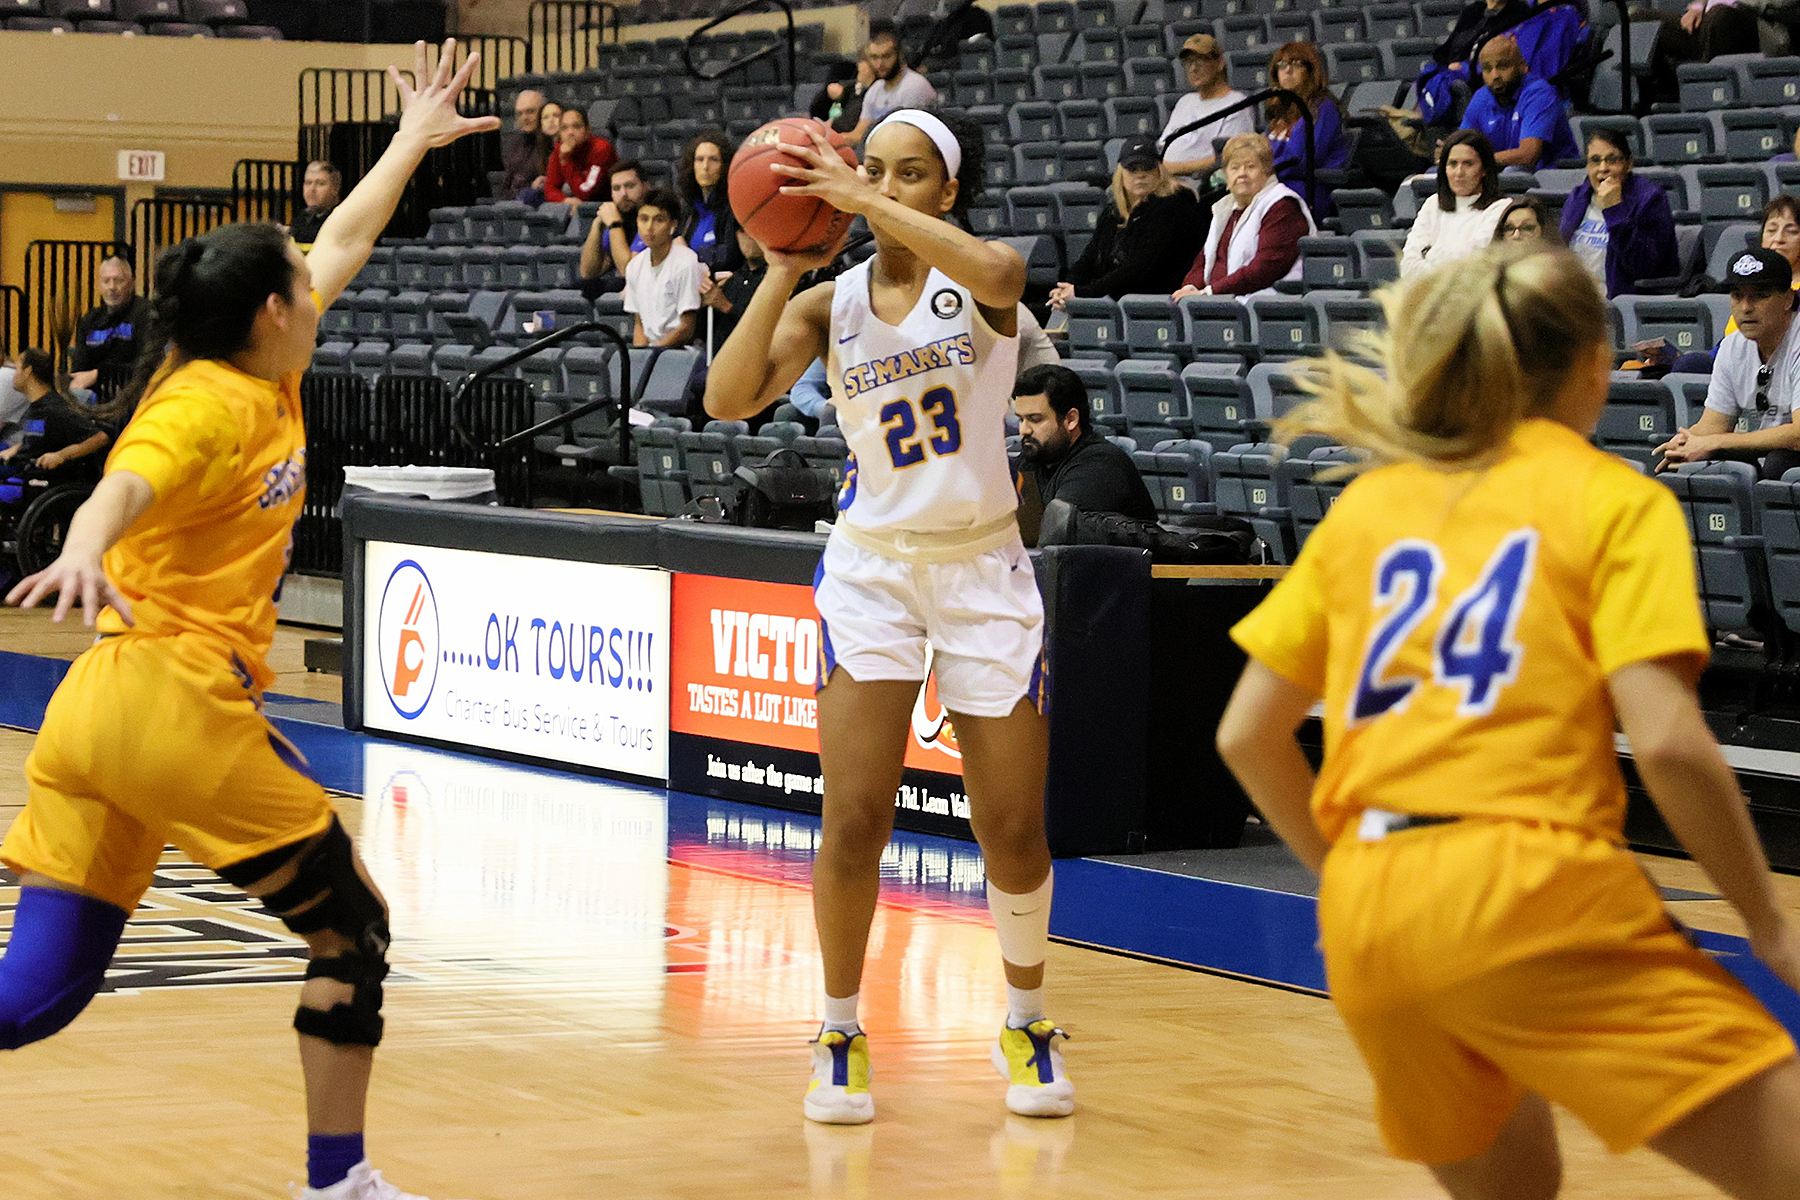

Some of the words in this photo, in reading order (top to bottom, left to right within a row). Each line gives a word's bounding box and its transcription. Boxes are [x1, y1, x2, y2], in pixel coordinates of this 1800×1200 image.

[128, 153, 156, 176] EXIT
[880, 383, 965, 471] 23
[1641, 417, 1653, 429] 12
[1254, 490, 1265, 502] 10
[1711, 515, 1724, 528] 15
[1346, 526, 1540, 730] 24
[530, 617, 653, 693] TOURS!!!
[445, 689, 498, 725] Charter
[503, 699, 529, 731] Bus
[534, 703, 588, 741] Service
[593, 712, 604, 743] &
[609, 715, 654, 751] Tours
[687, 682, 739, 718] TASTES
[740, 690, 752, 719] A
[754, 691, 782, 724] LOT
[783, 695, 818, 729] LIKE
[706, 753, 727, 779] Join
[728, 763, 741, 781] us
[741, 760, 766, 785] after
[766, 763, 783, 788] the
[784, 772, 812, 795] game
[813, 774, 825, 795] at
[899, 784, 921, 811] Rd.
[921, 788, 949, 816] Leon
